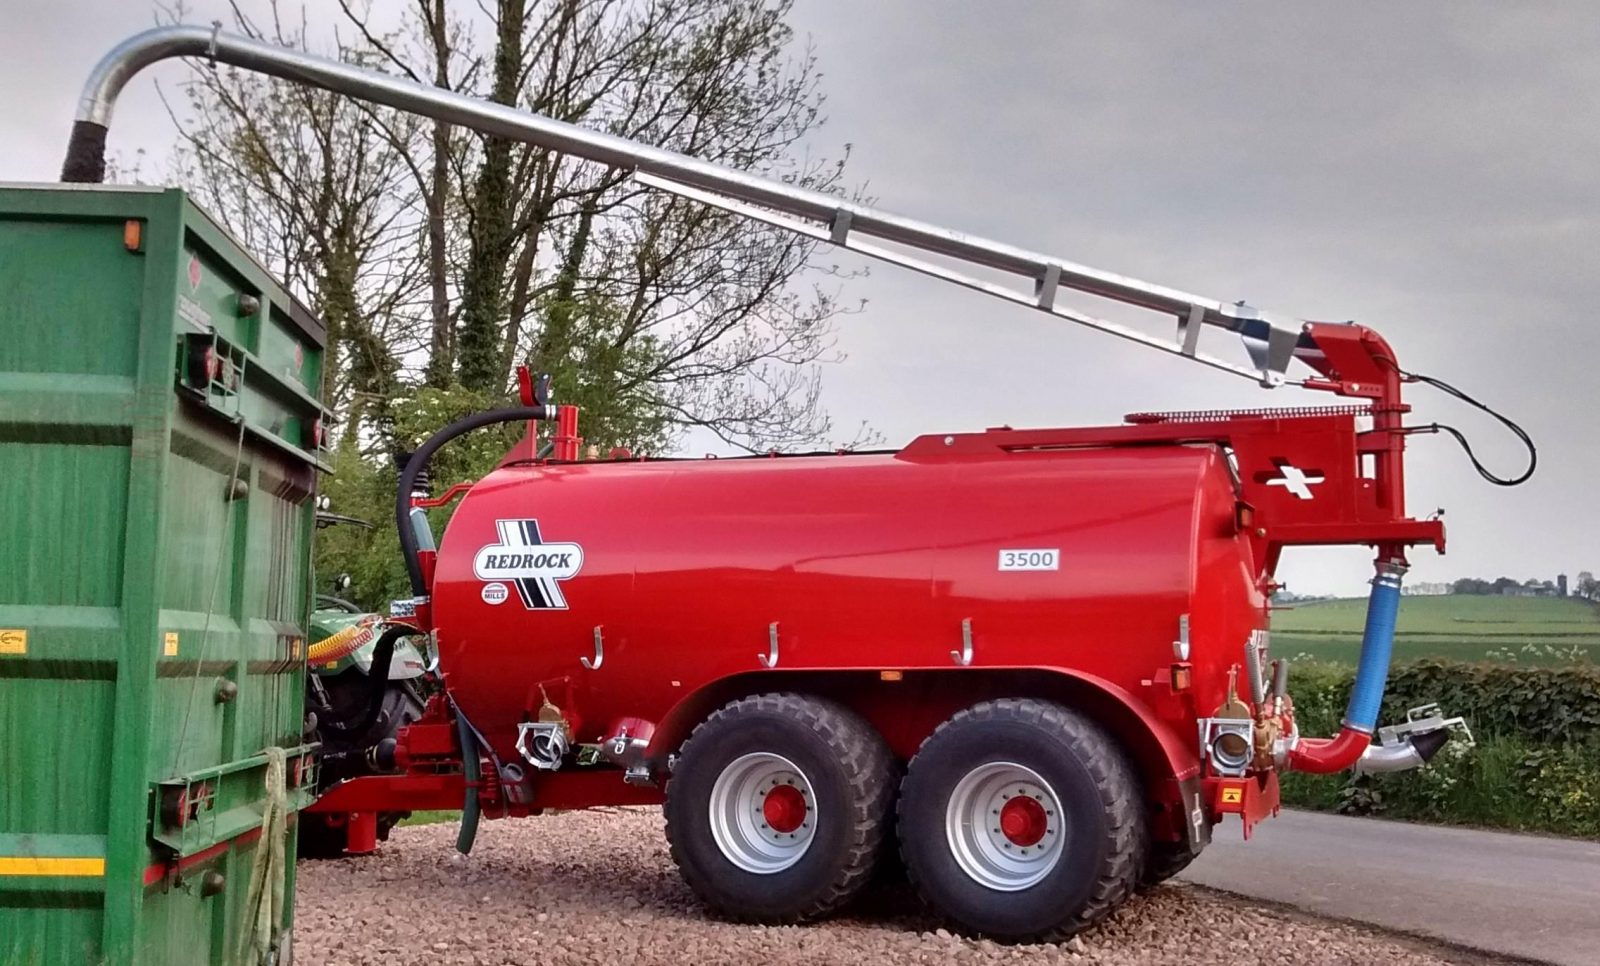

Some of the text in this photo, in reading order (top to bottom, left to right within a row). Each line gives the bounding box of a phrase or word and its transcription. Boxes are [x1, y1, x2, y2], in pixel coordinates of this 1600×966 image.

[484, 553, 572, 569] REDROCK
[1004, 552, 1053, 567] 3500
[484, 592, 505, 600] MILLS
